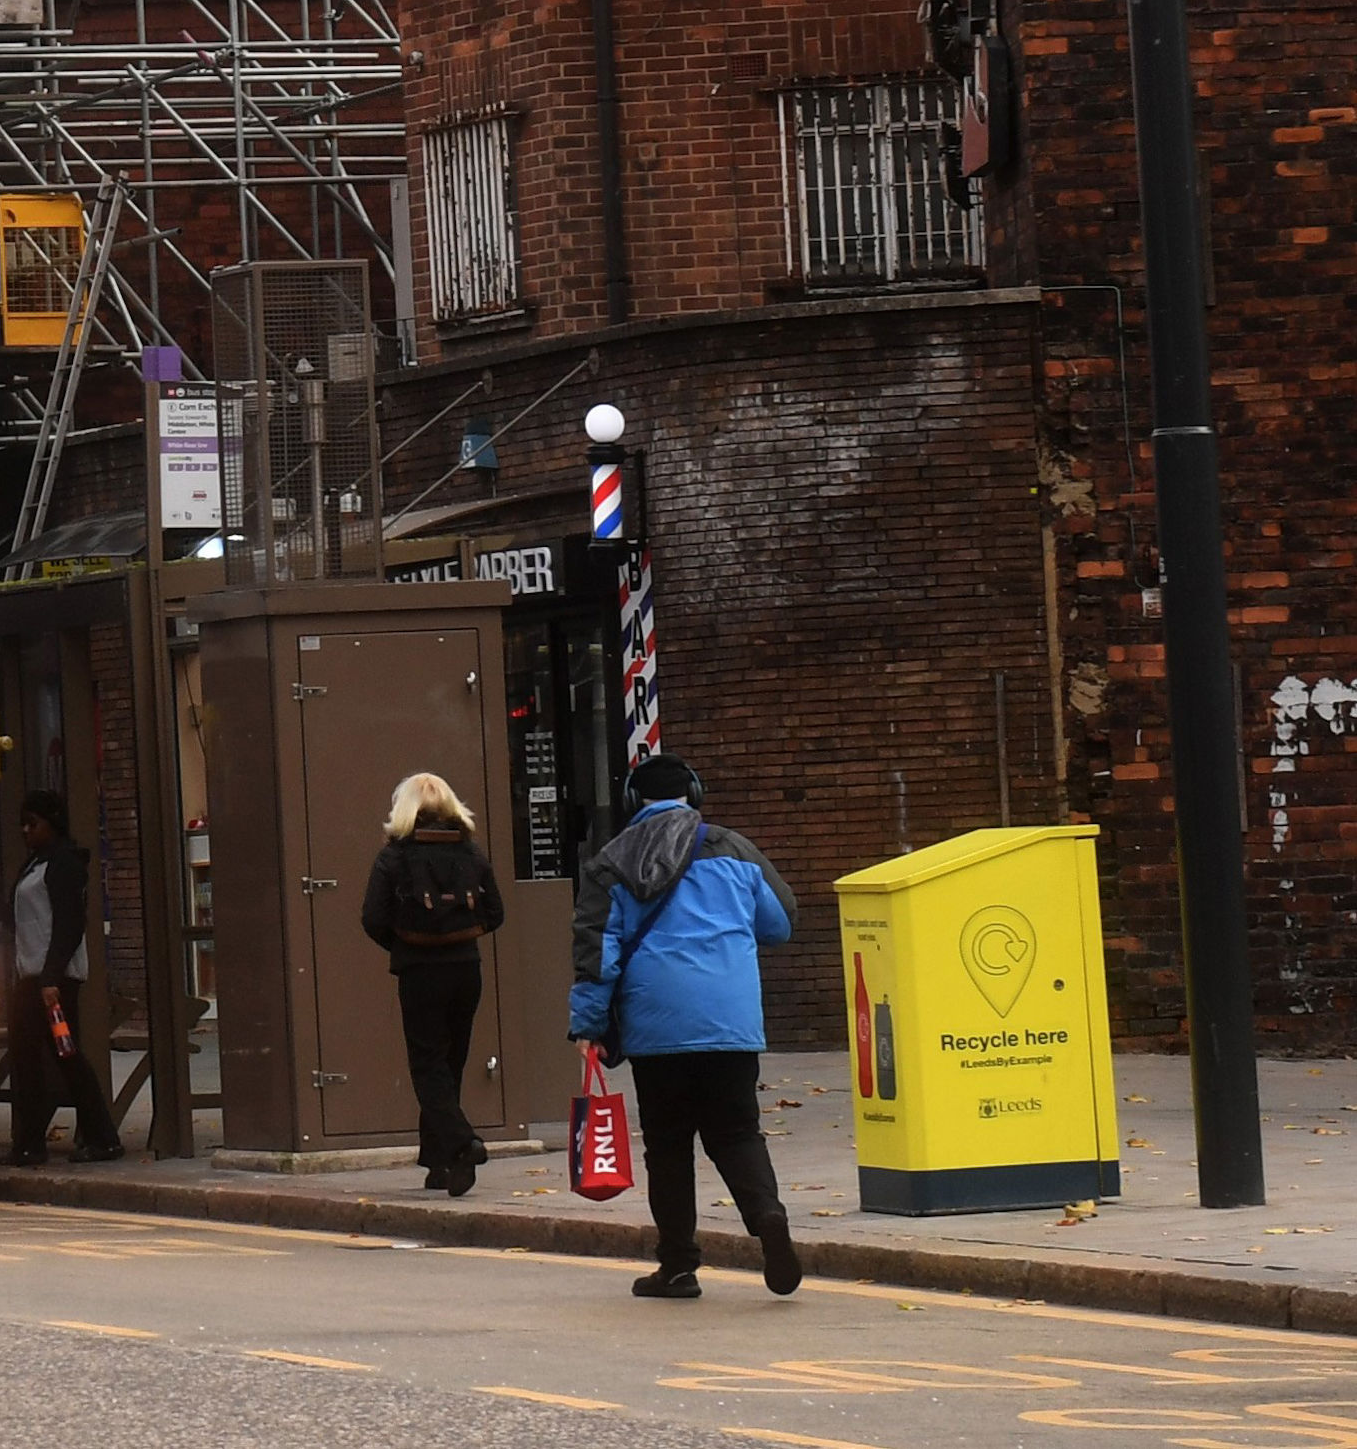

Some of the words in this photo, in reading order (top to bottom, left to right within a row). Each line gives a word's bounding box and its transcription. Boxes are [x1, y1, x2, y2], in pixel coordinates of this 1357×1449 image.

[474, 547, 554, 595] ARBER
[941, 1031, 1018, 1052] Recycle
[1025, 1029, 1068, 1046] here
[961, 1055, 1053, 1069] #LeedsByExample
[999, 1098, 1042, 1113] Leeds
[594, 1108, 618, 1174] RNLI
